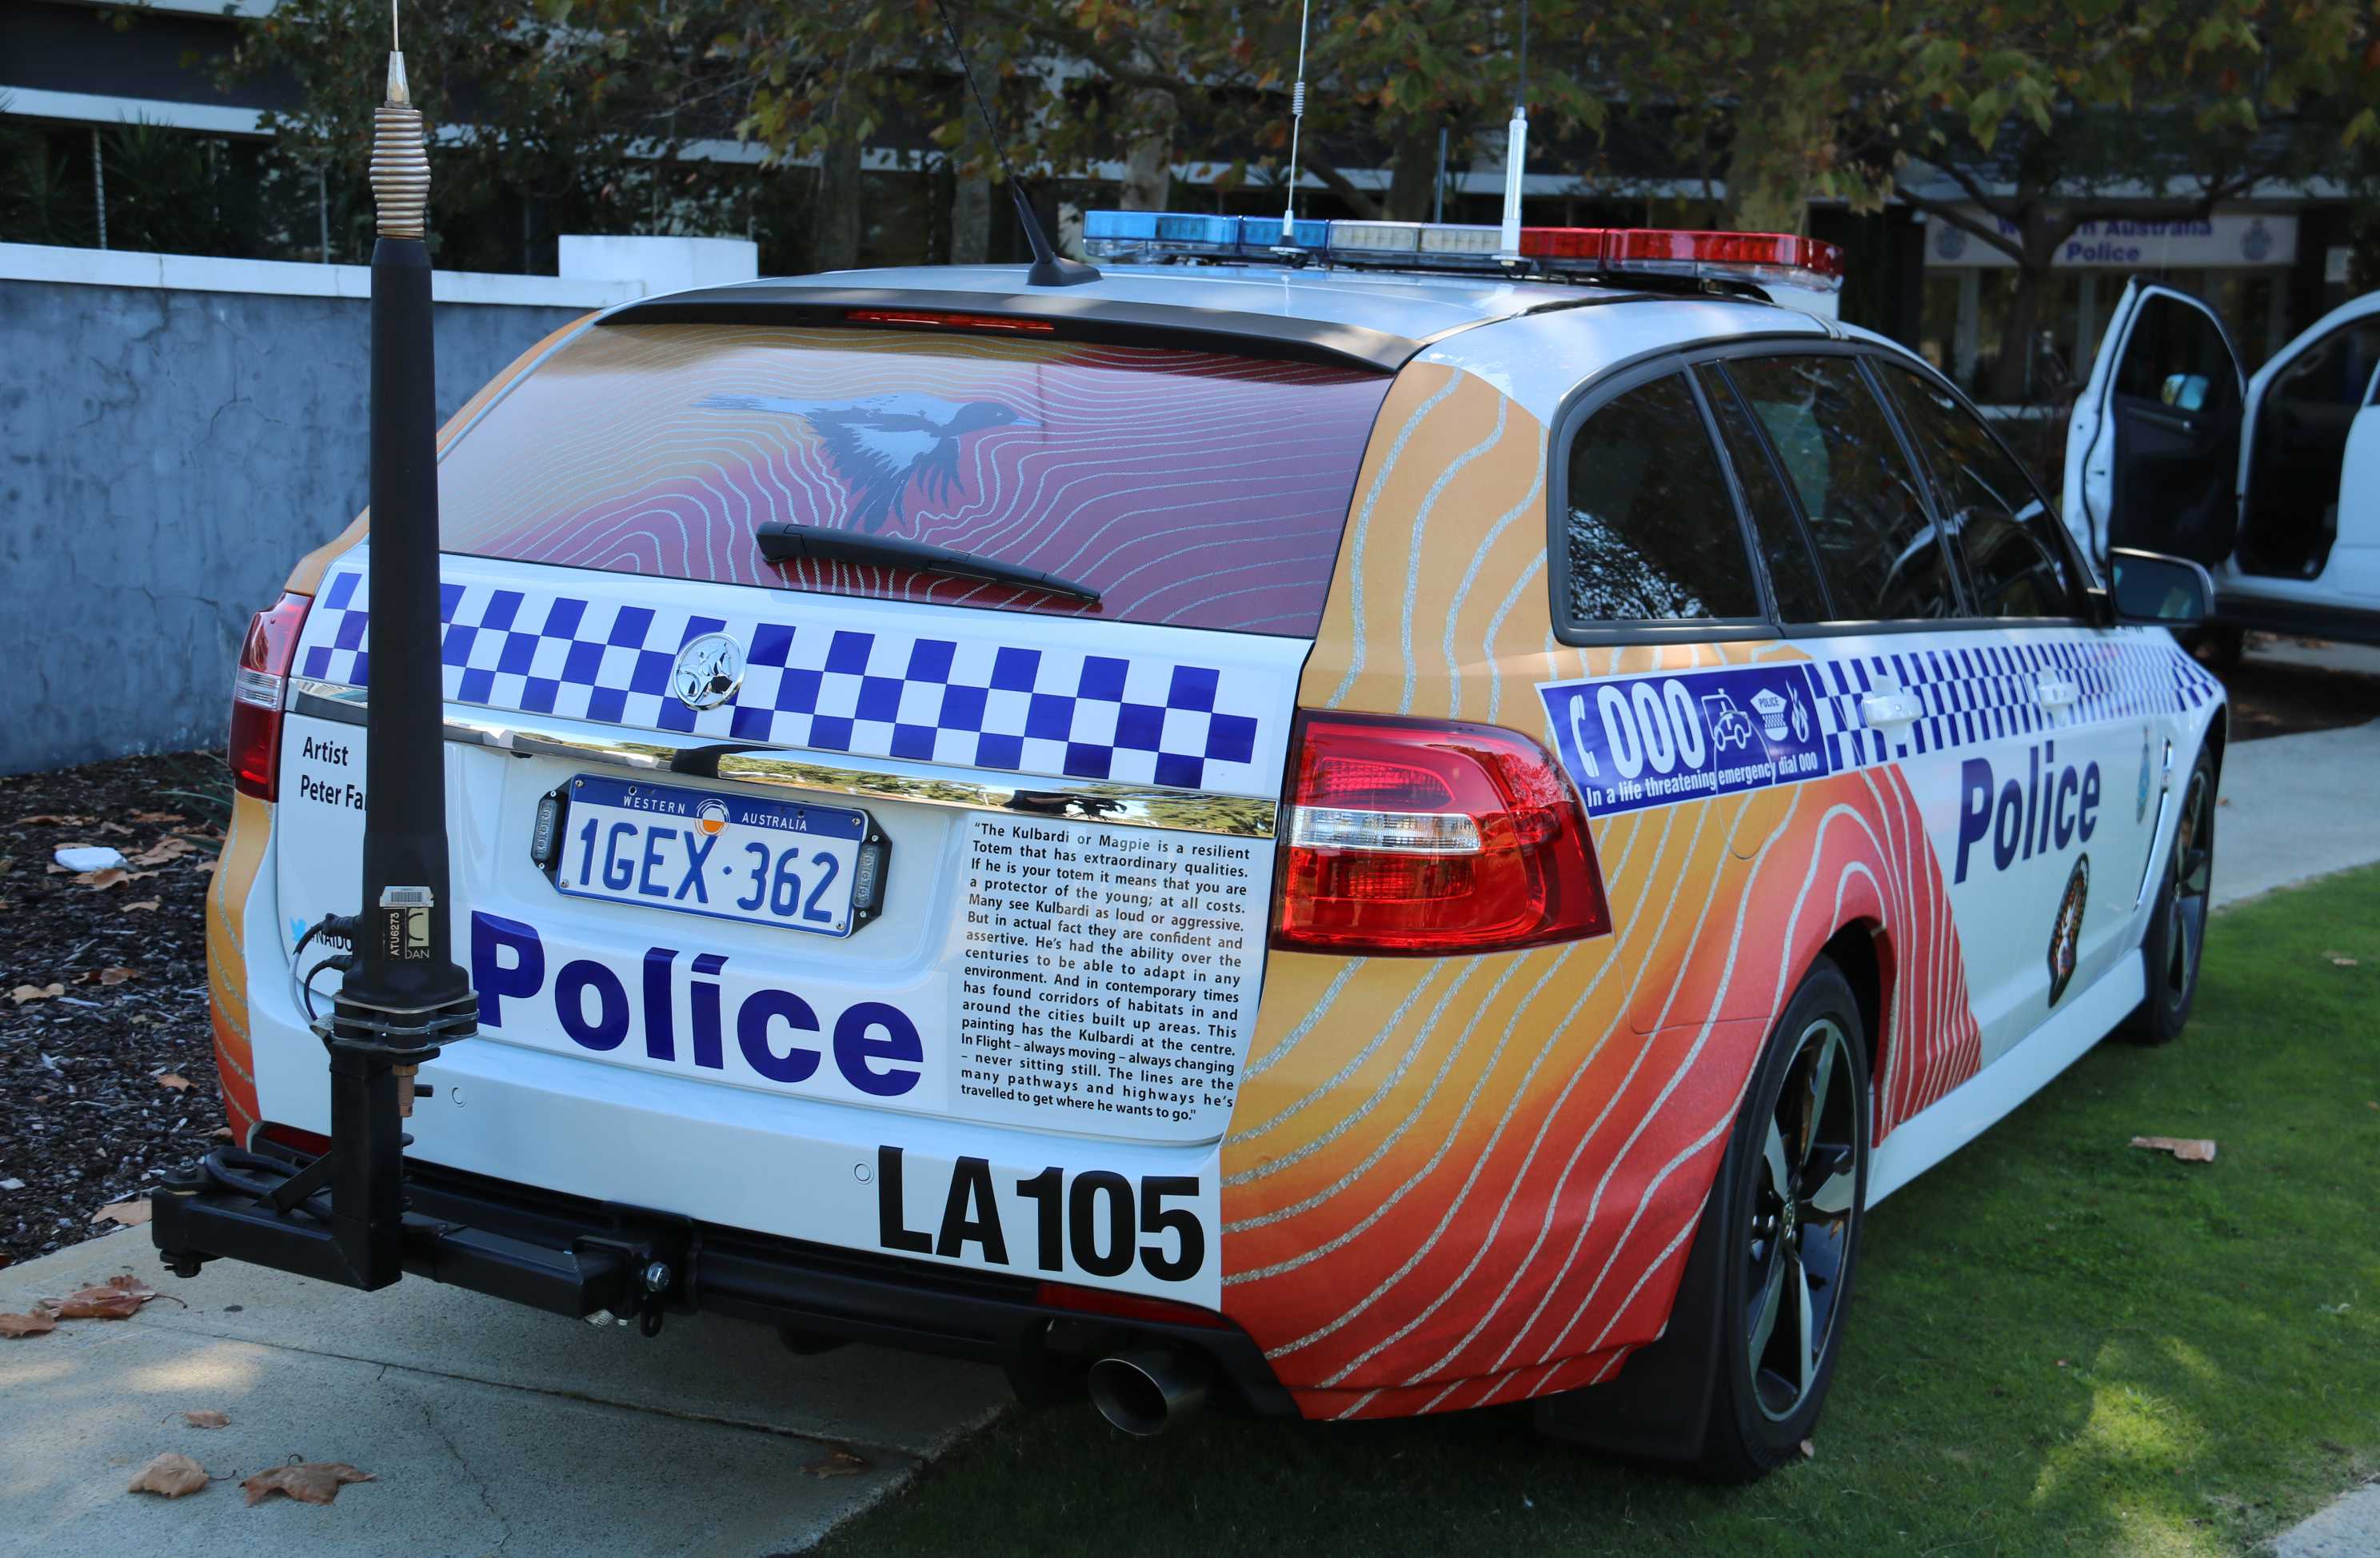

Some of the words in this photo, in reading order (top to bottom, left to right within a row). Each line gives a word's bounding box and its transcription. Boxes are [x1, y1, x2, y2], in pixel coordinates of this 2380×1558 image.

[2067, 242, 2141, 262] Police
[1758, 697, 1779, 708] POLICE
[1597, 678, 1706, 779] 000
[302, 736, 349, 766] Artist
[300, 774, 341, 805] Peter
[1587, 786, 1602, 808] In
[1607, 790, 1615, 805] a
[1619, 779, 1643, 802] life
[1645, 769, 1716, 797] threatening
[1718, 761, 1776, 785] emergency
[1779, 754, 1798, 776] dial
[1799, 752, 1819, 773] 000
[623, 795, 686, 814] WESTERN
[741, 812, 808, 832] AUSTRALIA
[1955, 740, 2101, 885] Police
[972, 840, 1012, 856] Totem
[1020, 845, 1047, 859] that
[1054, 847, 1076, 862] has
[1084, 853, 1177, 874] extraordinary
[1184, 862, 1248, 878] qualities.
[1012, 826, 1069, 843] Kulbardi
[1077, 836, 1092, 845] or
[1099, 834, 1150, 852] Magpie
[1158, 840, 1168, 853] is
[1176, 845, 1184, 853] a
[1192, 845, 1250, 860] resilient
[972, 857, 981, 870] If
[985, 858, 1000, 873] he
[1007, 861, 1016, 873] is
[1022, 865, 1051, 878] your
[1056, 868, 1094, 881] totem
[1100, 870, 1109, 883] it
[1115, 875, 1157, 888] means
[1163, 877, 1190, 891] that
[1196, 882, 1220, 895] you
[1226, 885, 1247, 896] are
[968, 893, 1003, 911] Many
[1008, 901, 1029, 911] see
[1036, 900, 1089, 917] Kulbardi
[1095, 909, 1109, 919] as
[1116, 908, 1144, 922] loud
[1151, 915, 1165, 924] or
[1171, 917, 1244, 932] aggressive.
[970, 878, 976, 887] a
[984, 880, 1048, 895] protector
[1055, 885, 1069, 897] of
[1076, 886, 1098, 900] the
[1105, 892, 1152, 908] young;
[1160, 896, 1174, 907] at
[1181, 897, 1198, 909] all
[1206, 901, 1245, 913] costs.
[311, 929, 353, 952] NAIDO
[968, 911, 989, 925] But
[995, 913, 1007, 926] in
[1013, 918, 1052, 931] actual
[1057, 920, 1082, 934] fact
[1088, 923, 1116, 941] they
[1123, 929, 1143, 940] are
[1150, 931, 1212, 947] confident
[1218, 937, 1243, 949] and
[966, 931, 1028, 946] assertive.
[1069, 938, 1094, 953] had
[1101, 942, 1123, 956] the
[1131, 945, 1174, 964] ability
[1181, 953, 1212, 965] over
[1219, 954, 1241, 967] the
[964, 965, 1047, 984] environment.
[1054, 973, 1080, 987] And
[1087, 976, 1098, 989] in
[1105, 981, 1196, 1002] contemporary
[1204, 989, 1239, 1003] times
[965, 949, 1028, 964] centuries
[1036, 955, 1051, 966] to
[1059, 955, 1076, 969] be
[1083, 959, 1113, 973] able
[1121, 964, 1136, 975] to
[1144, 965, 1185, 982] adapt
[1193, 969, 1206, 982] in
[1215, 974, 1240, 988] any
[471, 910, 924, 1097] Police
[964, 980, 985, 994] has
[992, 984, 1032, 1000] found
[1039, 992, 1099, 1007] corridors
[1107, 997, 1121, 1009] of
[1128, 998, 1184, 1016] habitats
[1192, 1005, 1204, 1017] in
[1212, 1009, 1238, 1021] and
[962, 1001, 1011, 1015] around
[1018, 1005, 1040, 1018] the
[1048, 1008, 1084, 1023] cities
[1092, 1012, 1125, 1028] built
[1133, 1020, 1151, 1033] up
[1158, 1022, 1200, 1035] areas.
[1208, 1024, 1236, 1038] This
[962, 1017, 1014, 1036] painting
[1022, 1021, 1044, 1037] has
[1050, 1025, 1072, 1039] the
[1079, 1029, 1134, 1046] Kulbardi
[1141, 1037, 1154, 1049] at
[1161, 1037, 1183, 1051] the
[1190, 1043, 1235, 1056] centre.
[961, 1033, 972, 1045] In
[976, 1034, 1011, 1051] Flight
[1024, 1041, 1065, 1058] always
[1068, 1048, 1116, 1065] moving
[1128, 1052, 1172, 1069] always
[1174, 1057, 1234, 1077] changing
[976, 1054, 1012, 1066] never
[1020, 1057, 1064, 1076] sitting
[1071, 1064, 1101, 1077] still.
[1108, 1066, 1133, 1081] The
[1140, 1069, 1173, 1085] lines
[1181, 1077, 1203, 1088] are
[1211, 1077, 1234, 1090] the
[960, 1084, 1014, 1101] travelled
[1017, 1091, 1030, 1102] to
[1033, 1095, 1053, 1106] get
[1056, 1095, 1095, 1110] where
[1097, 1099, 1112, 1112] he
[1116, 1104, 1153, 1117] wants
[1156, 1107, 1169, 1118] to
[961, 1069, 1000, 1085] many
[1008, 1075, 1078, 1093] pathways
[1086, 1083, 1114, 1095] and
[1123, 1085, 1195, 1105] highways
